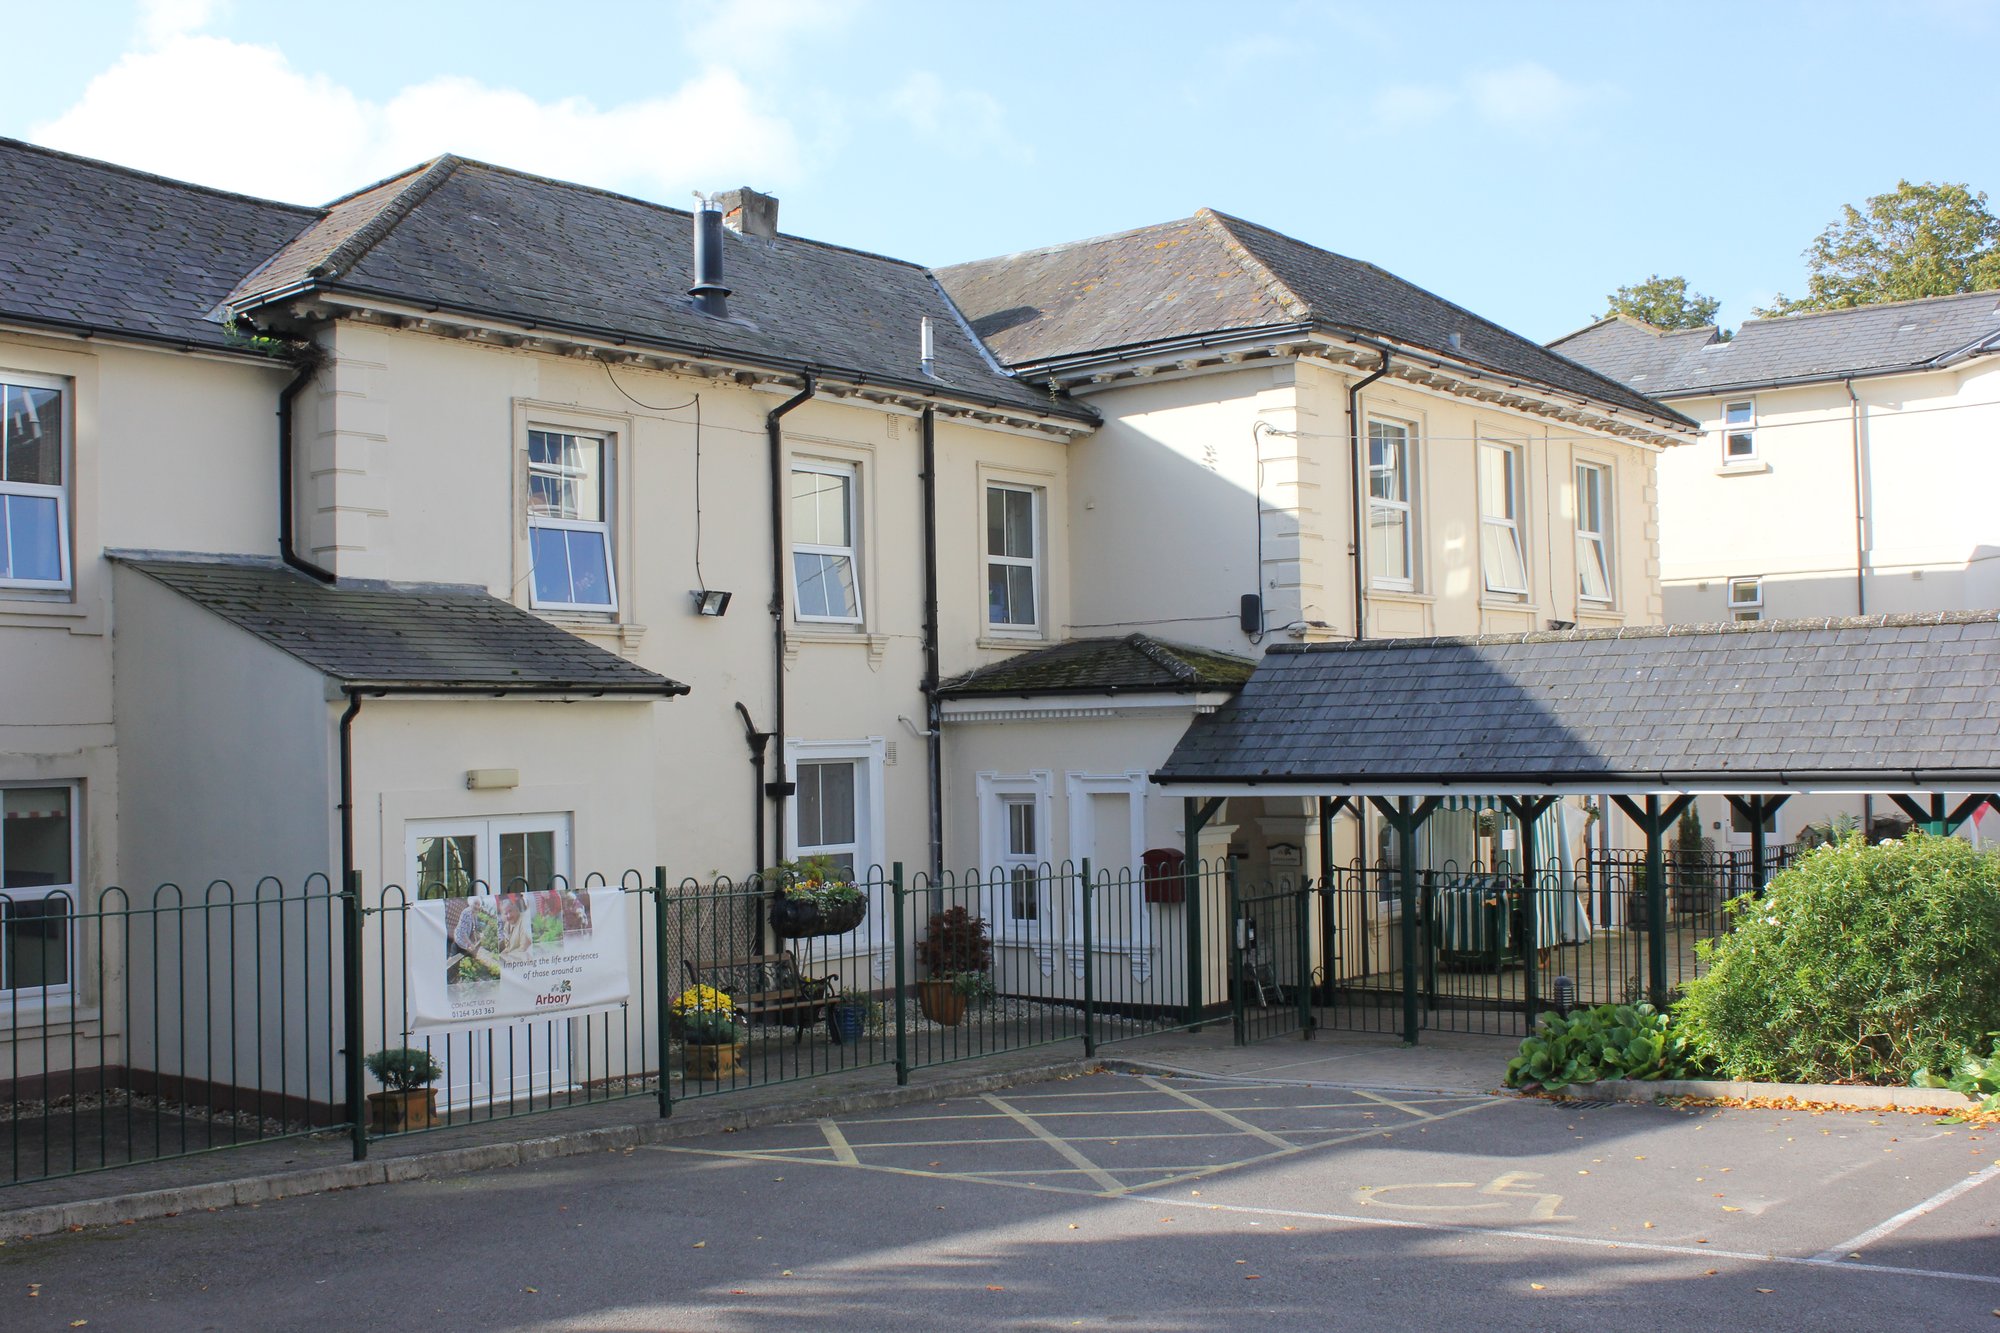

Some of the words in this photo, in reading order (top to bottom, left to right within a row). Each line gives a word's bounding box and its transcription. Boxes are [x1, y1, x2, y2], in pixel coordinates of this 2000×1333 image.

[503, 959, 537, 969] Improving
[539, 957, 549, 965] the
[552, 955, 561, 964] life
[563, 953, 599, 963] experiences
[523, 970, 531, 980] of
[532, 969, 549, 978] those
[551, 966, 573, 976] around
[451, 1001, 477, 1009] CONTACT
[535, 993, 571, 1006] Arbory
[451, 1009, 470, 1018] 01264
[484, 1007, 494, 1015] 363
